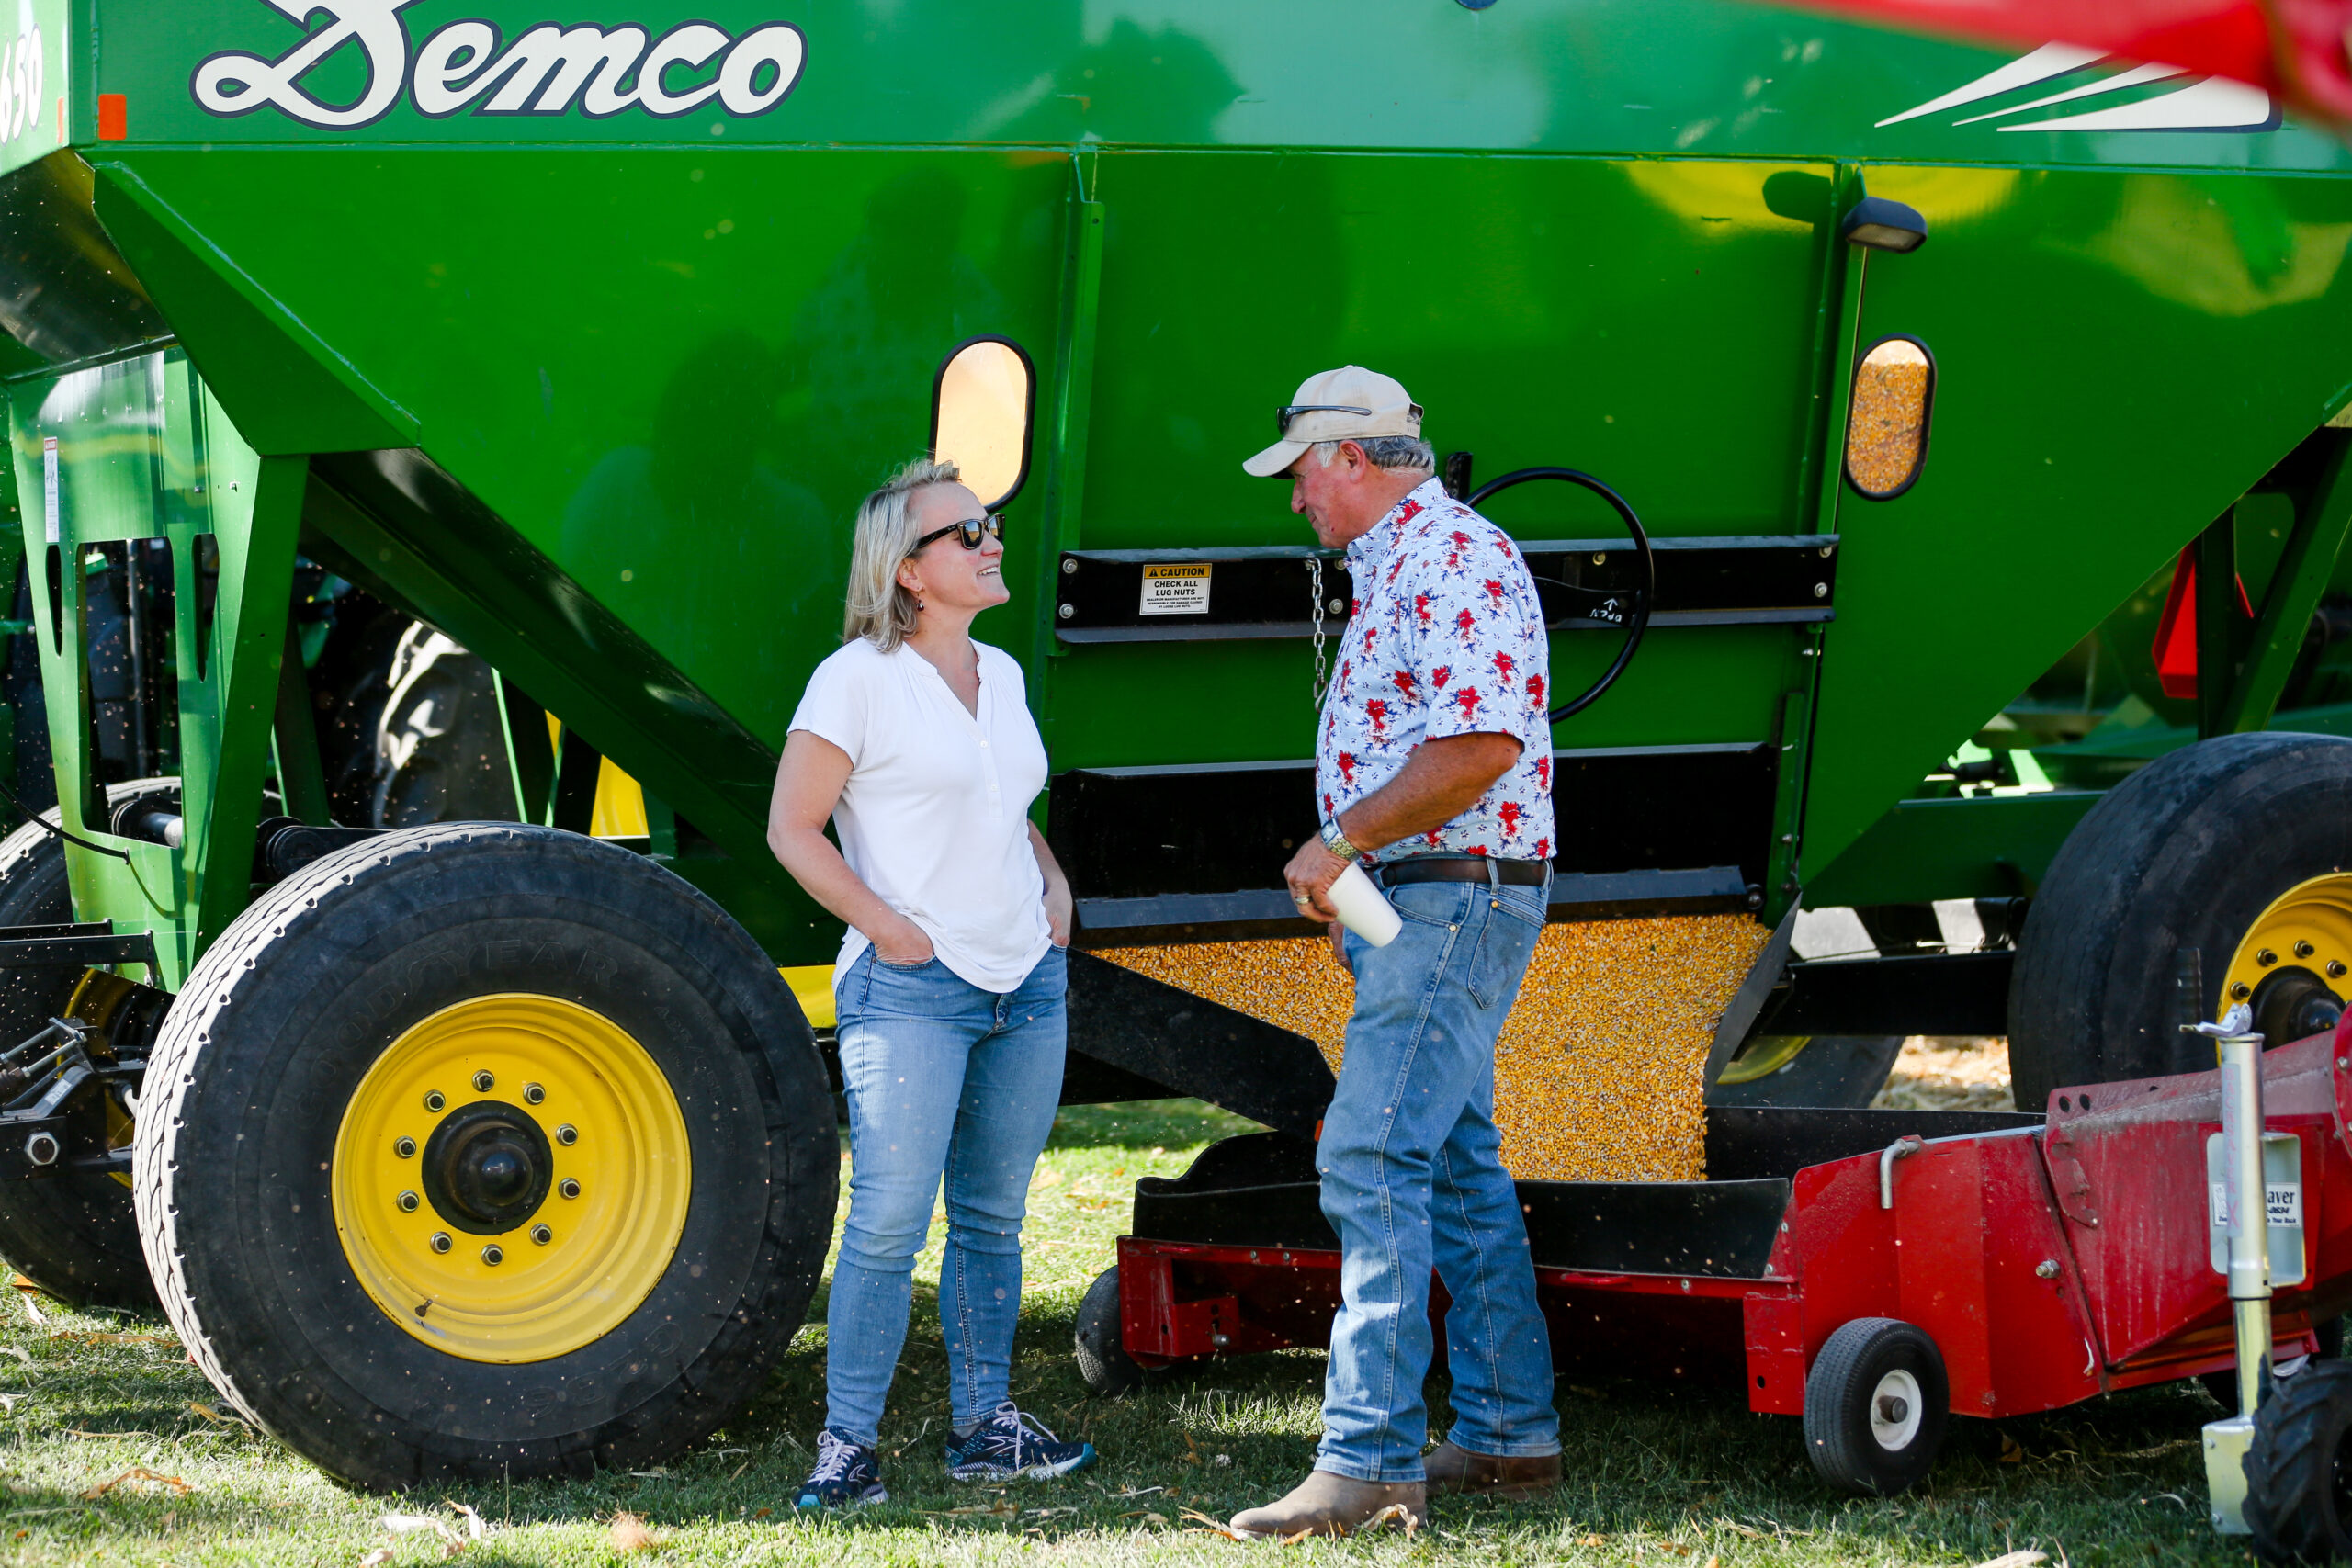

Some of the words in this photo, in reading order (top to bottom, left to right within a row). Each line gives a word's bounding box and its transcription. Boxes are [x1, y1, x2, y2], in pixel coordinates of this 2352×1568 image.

[0, 23, 43, 147] 650
[188, 0, 808, 131] Demco
[1160, 567, 1204, 577] CAUTION
[1173, 588, 1196, 596] NUTS
[295, 938, 621, 1130] GOODYEAR
[2267, 1190, 2296, 1205] aver
